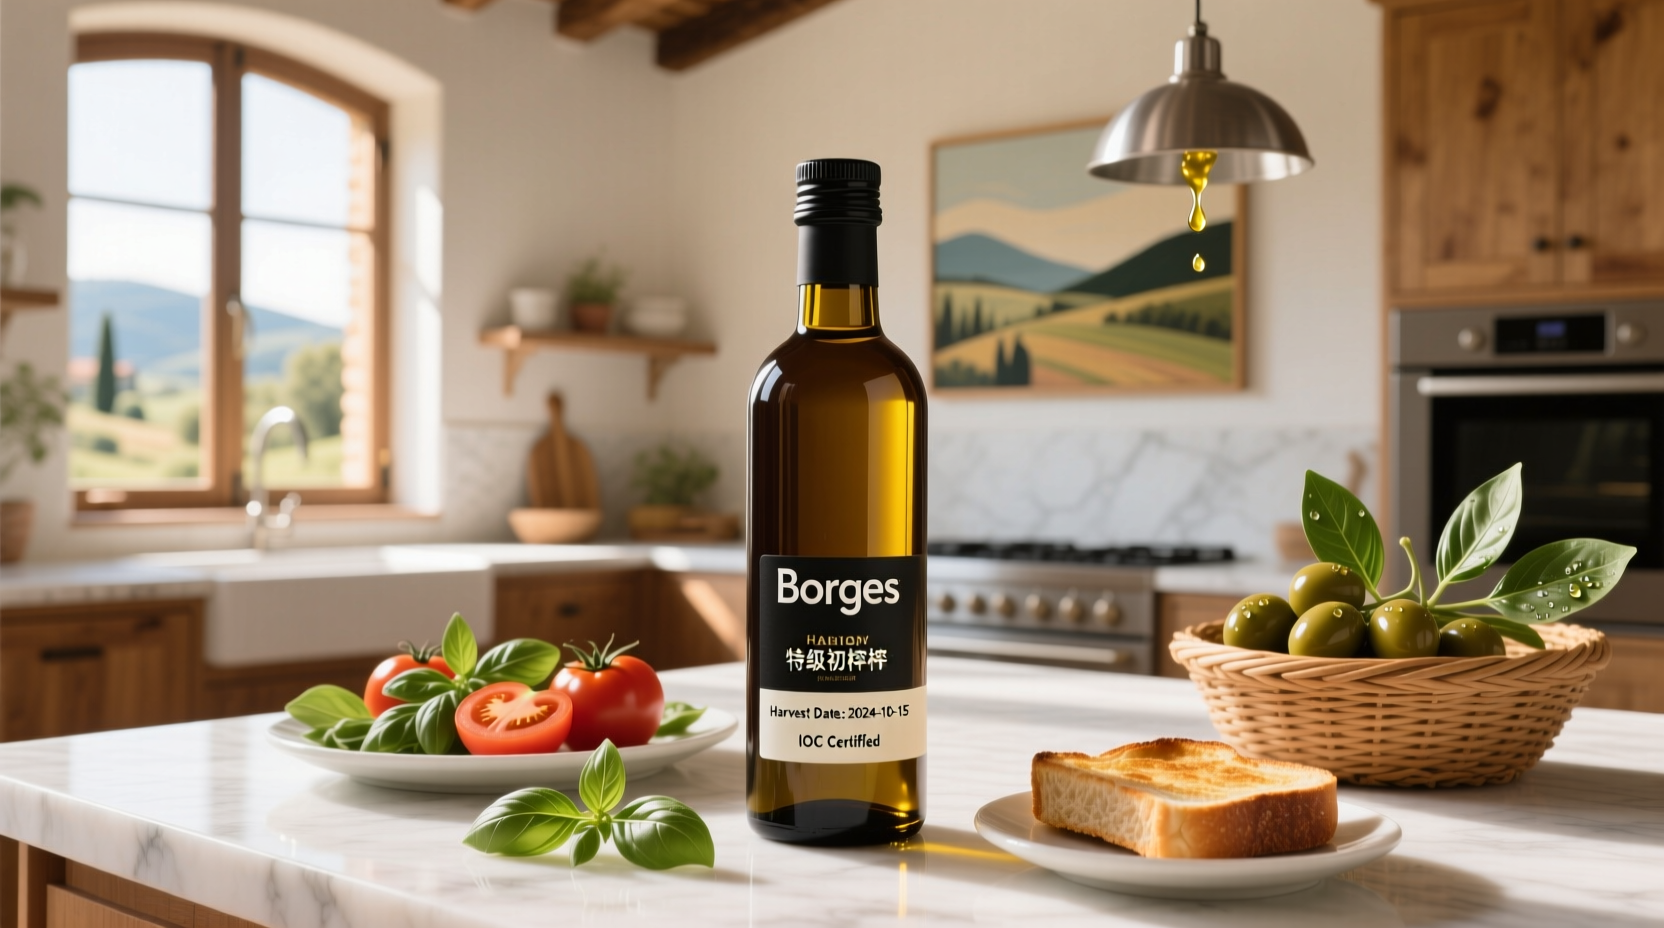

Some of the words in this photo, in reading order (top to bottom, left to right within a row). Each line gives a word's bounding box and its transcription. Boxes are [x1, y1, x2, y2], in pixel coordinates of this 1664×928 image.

[777, 567, 900, 616] Borges
[770, 704, 810, 718] Harvest
[814, 706, 845, 719] Date:
[848, 704, 910, 719] 2024-10-15
[799, 734, 823, 748] IOC
